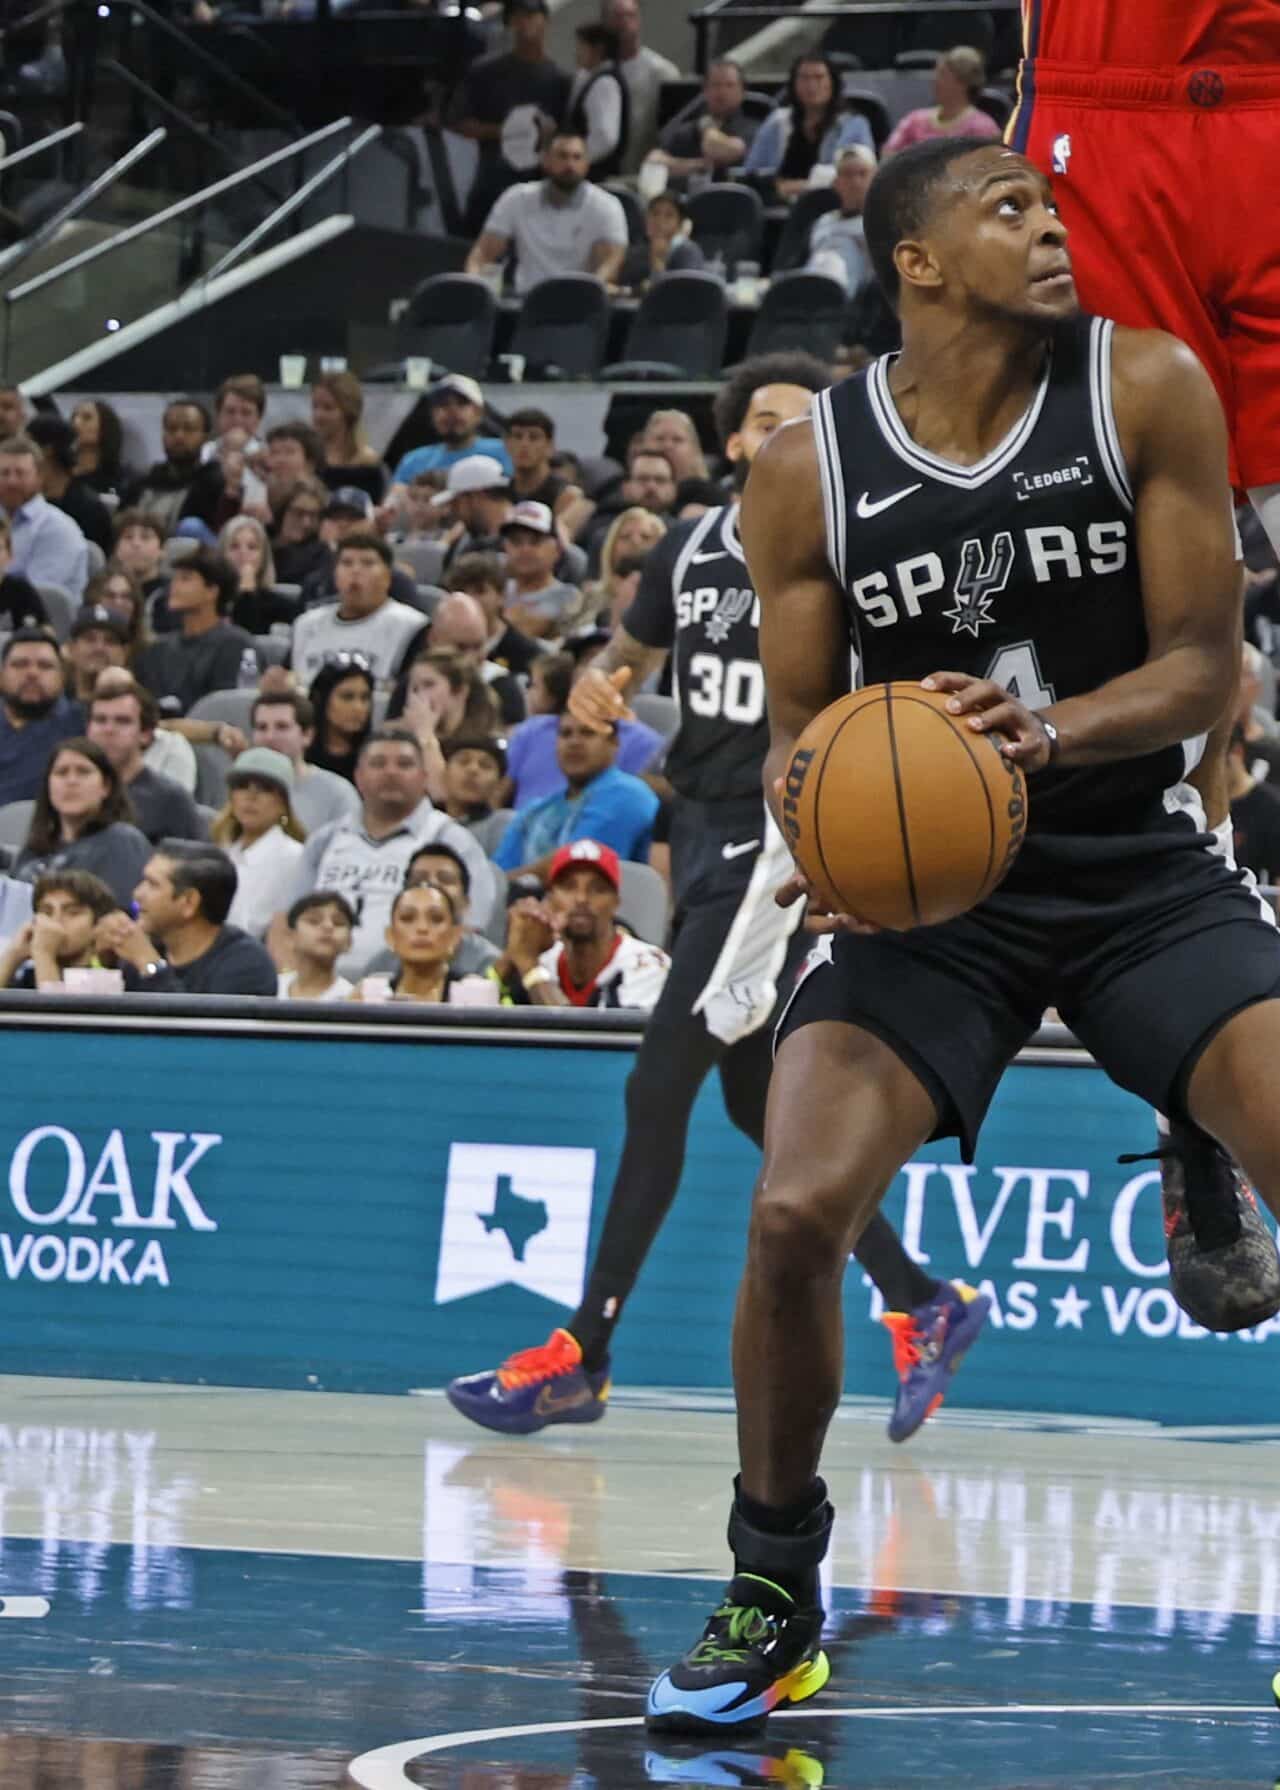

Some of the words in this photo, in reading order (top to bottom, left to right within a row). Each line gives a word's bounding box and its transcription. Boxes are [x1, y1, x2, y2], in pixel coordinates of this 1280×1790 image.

[1023, 466, 1082, 491] LEDGER
[852, 520, 1128, 638] SPURS
[688, 651, 765, 726] 30
[983, 639, 1057, 713] 4
[8, 1124, 223, 1232] OAK
[900, 1162, 1091, 1272] IVE
[0, 1232, 170, 1287] VODKA
